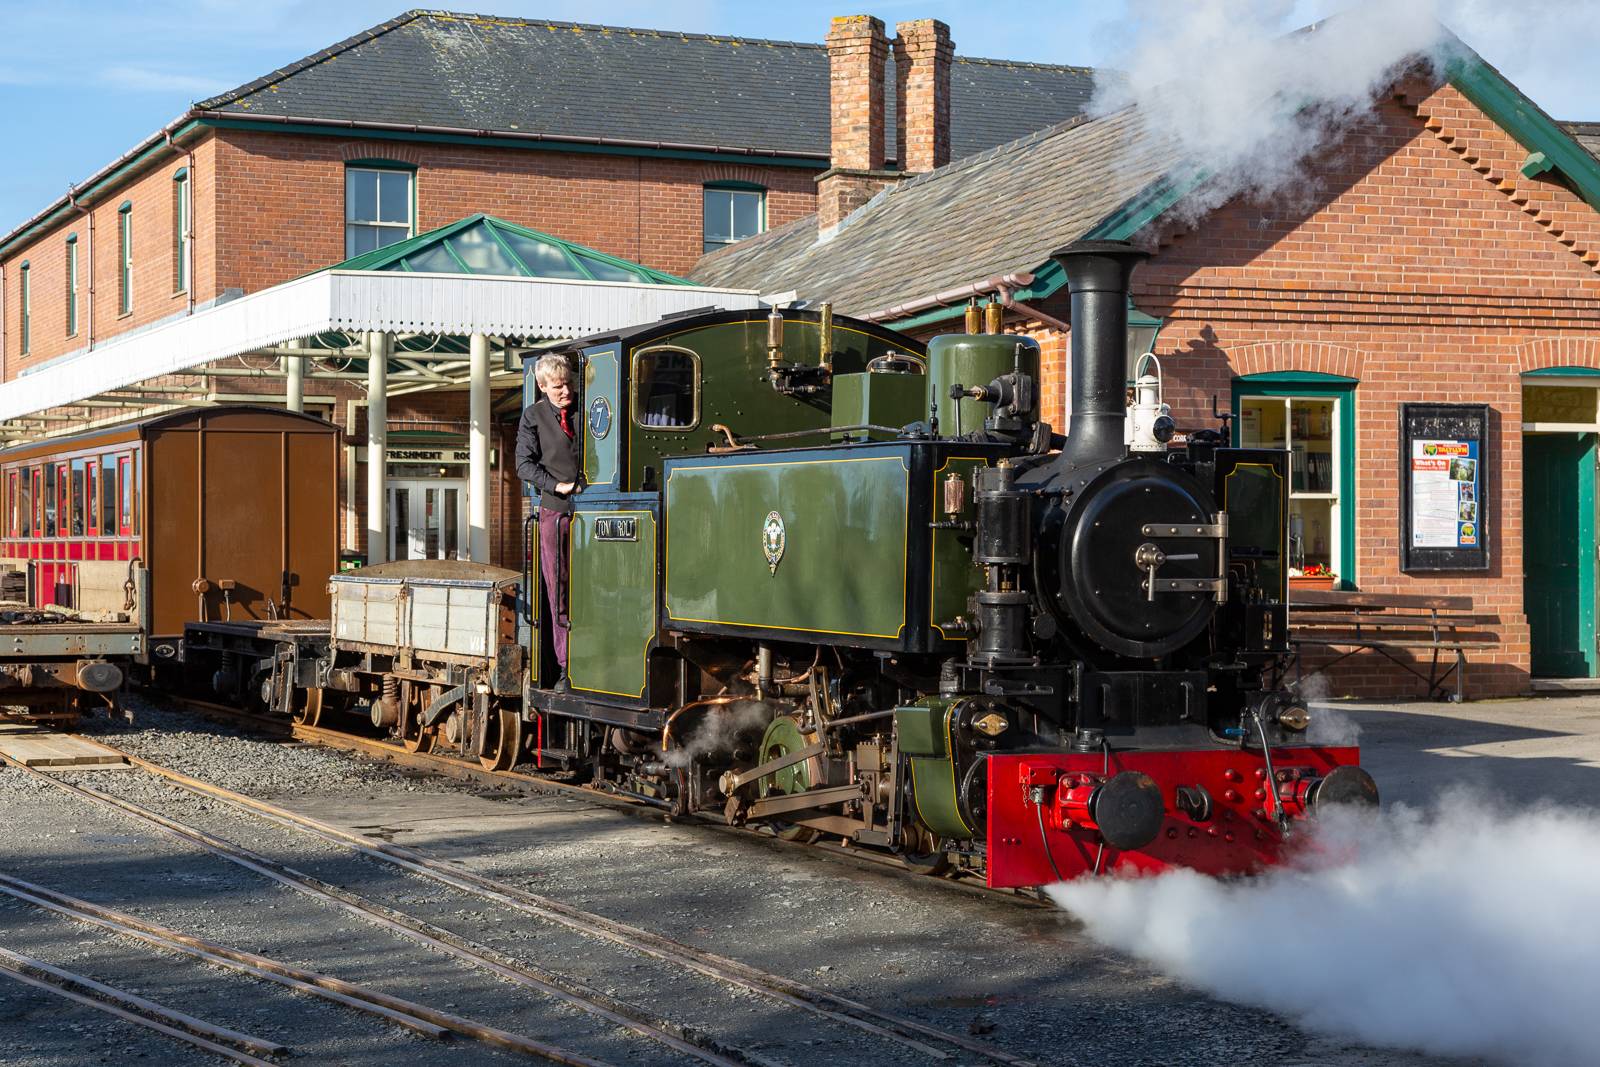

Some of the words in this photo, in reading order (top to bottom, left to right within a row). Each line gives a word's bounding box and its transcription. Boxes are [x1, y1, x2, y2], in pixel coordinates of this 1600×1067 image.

[596, 407, 604, 428] 7
[386, 451, 443, 460] FRESHMENT
[453, 451, 470, 460] ROO
[617, 520, 634, 537] ROLT
